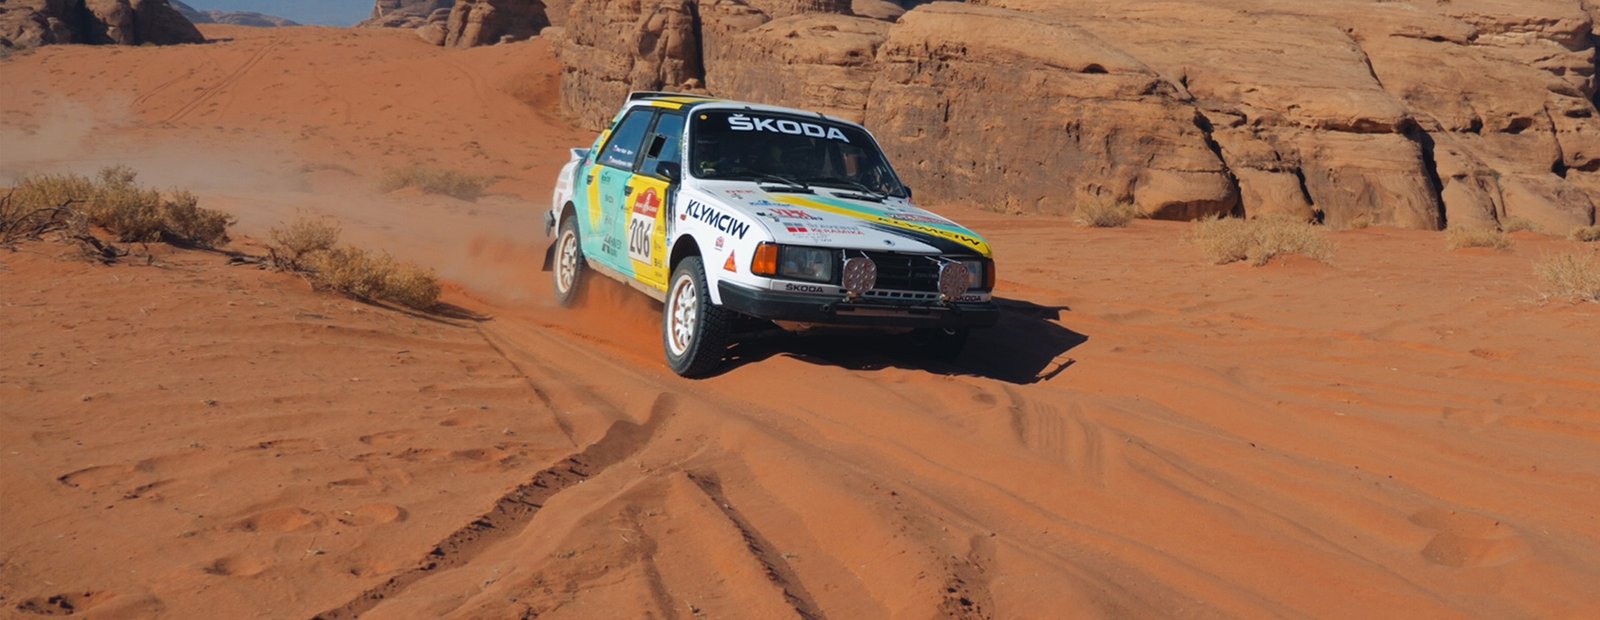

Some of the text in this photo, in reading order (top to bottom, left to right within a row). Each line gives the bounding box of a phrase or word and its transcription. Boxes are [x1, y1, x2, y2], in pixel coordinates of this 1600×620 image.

[727, 113, 850, 143] ŠKODA
[685, 199, 750, 240] KLYMCIW
[878, 217, 980, 246] KLYMCIW
[629, 218, 650, 258] 206
[785, 283, 824, 294] ŠKODA
